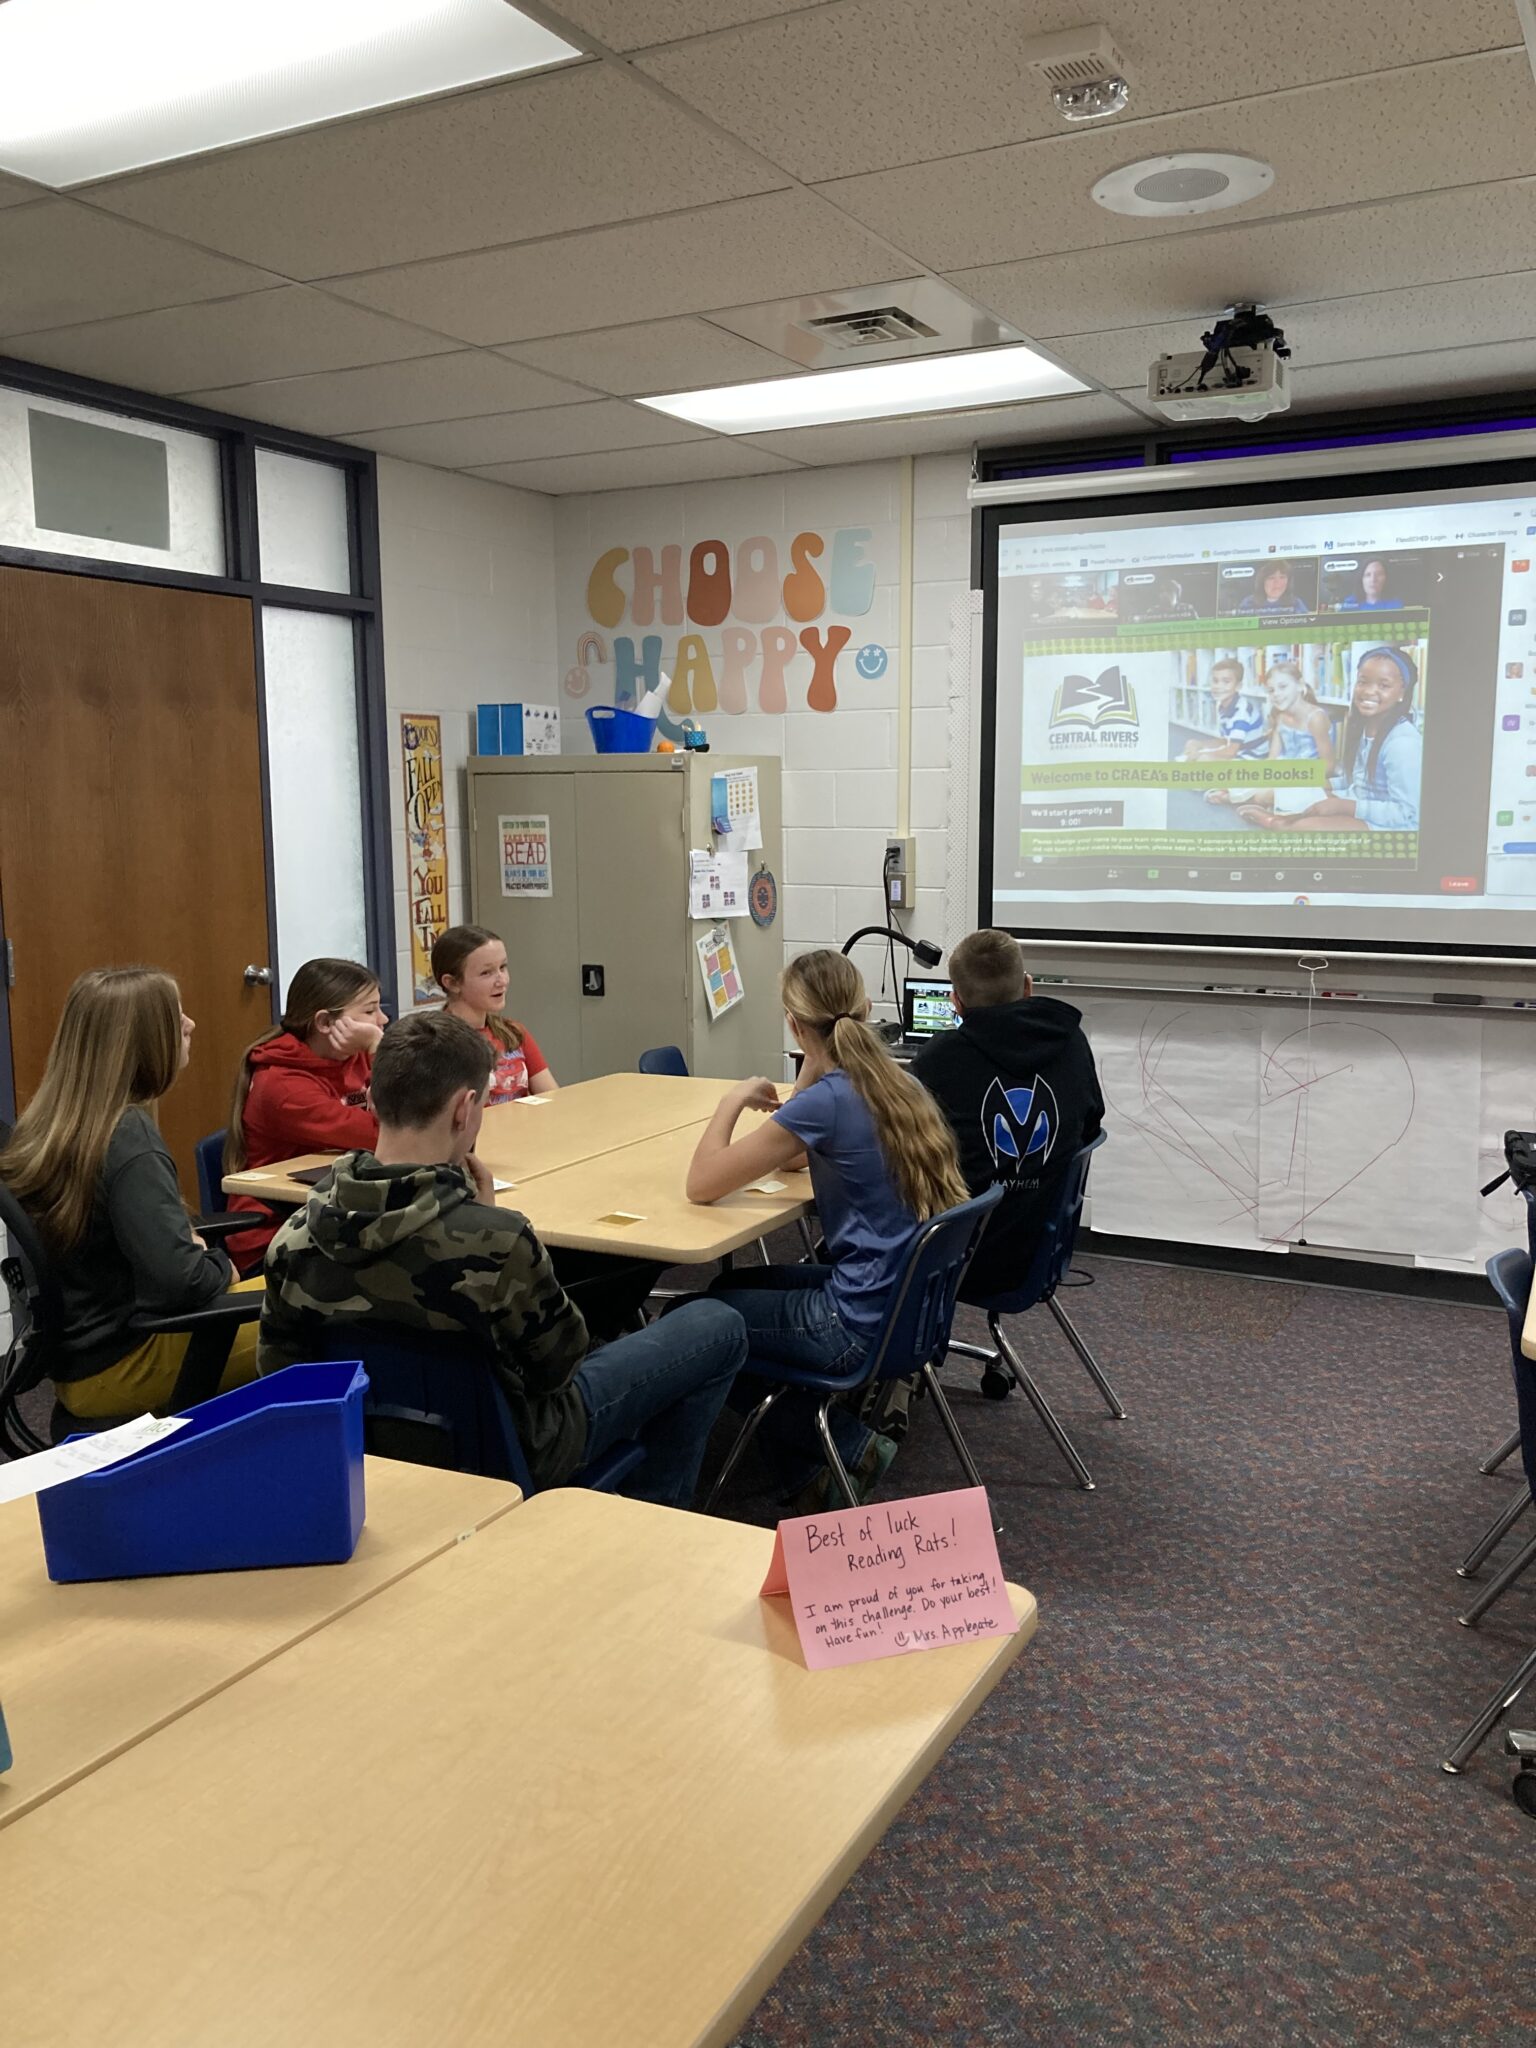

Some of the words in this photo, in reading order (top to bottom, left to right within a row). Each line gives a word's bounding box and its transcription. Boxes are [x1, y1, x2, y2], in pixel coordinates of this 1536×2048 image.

[587, 528, 876, 629] CHOOSE
[1280, 616, 1307, 626] Options
[613, 625, 852, 722] HAPPY
[1049, 731, 1098, 744] CENTRAL
[1100, 730, 1140, 742] RIVERS
[406, 757, 436, 805] FALL
[1031, 771, 1092, 784] Welcome
[1095, 770, 1109, 780] to
[1112, 768, 1168, 782] CRAEA's
[1172, 770, 1214, 782] Battle
[1217, 768, 1233, 781] of
[1236, 768, 1260, 780] the
[1263, 768, 1314, 780] Books!
[1031, 808, 1048, 816] We'll
[1049, 808, 1068, 816] start
[1069, 806, 1103, 816] promptly
[1104, 806, 1113, 814] at
[504, 842, 546, 865] READ
[414, 866, 443, 896] YOU
[412, 898, 445, 924] FALL
[418, 926, 442, 952] IN
[805, 1522, 846, 1553] Best
[859, 1516, 873, 1541] of
[887, 1511, 920, 1534] luck
[848, 1544, 906, 1572] Reading
[914, 1518, 959, 1555] Rats!
[804, 1604, 816, 1619] I
[824, 1602, 844, 1613] am
[850, 1589, 880, 1612] proud
[888, 1586, 899, 1600] of
[906, 1586, 924, 1601] you
[930, 1578, 946, 1592] for
[950, 1572, 986, 1587] taking
[816, 1625, 827, 1634] on
[830, 1617, 854, 1630] this
[862, 1604, 916, 1624] challenge.
[922, 1598, 936, 1612] Do
[940, 1592, 963, 1610] your
[967, 1576, 997, 1598] best!
[825, 1634, 853, 1648] Have
[856, 1623, 884, 1642] fun!
[913, 1630, 939, 1644] Mrs.
[942, 1616, 999, 1640] Applegate
